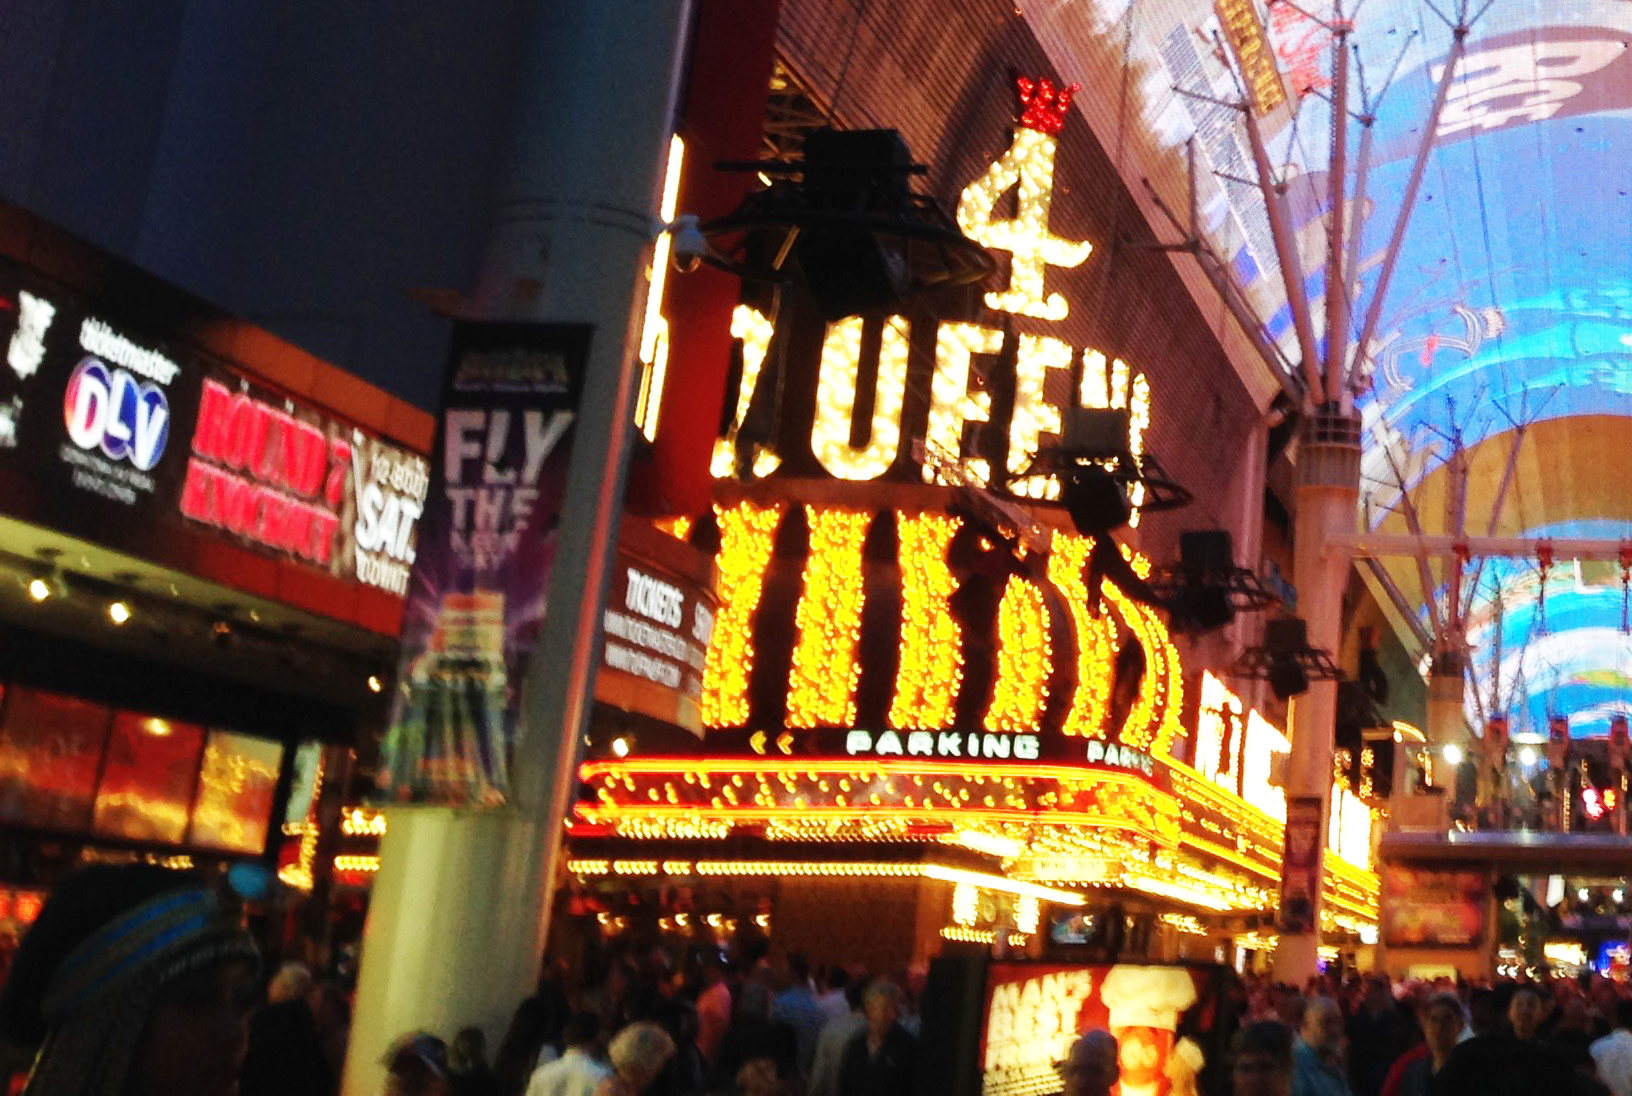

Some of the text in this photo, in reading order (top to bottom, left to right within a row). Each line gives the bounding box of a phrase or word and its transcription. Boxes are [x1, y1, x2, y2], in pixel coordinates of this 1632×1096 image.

[957, 127, 1092, 321] 4
[79, 316, 181, 385] ticketmaster
[69, 369, 167, 471] DLV
[444, 407, 576, 486] FLY
[445, 489, 539, 531] THE
[625, 567, 684, 629] TICKETS
[846, 729, 1040, 760] PARKING
[990, 969, 1092, 1011] MAN'S
[988, 1000, 1082, 1043] BEST
